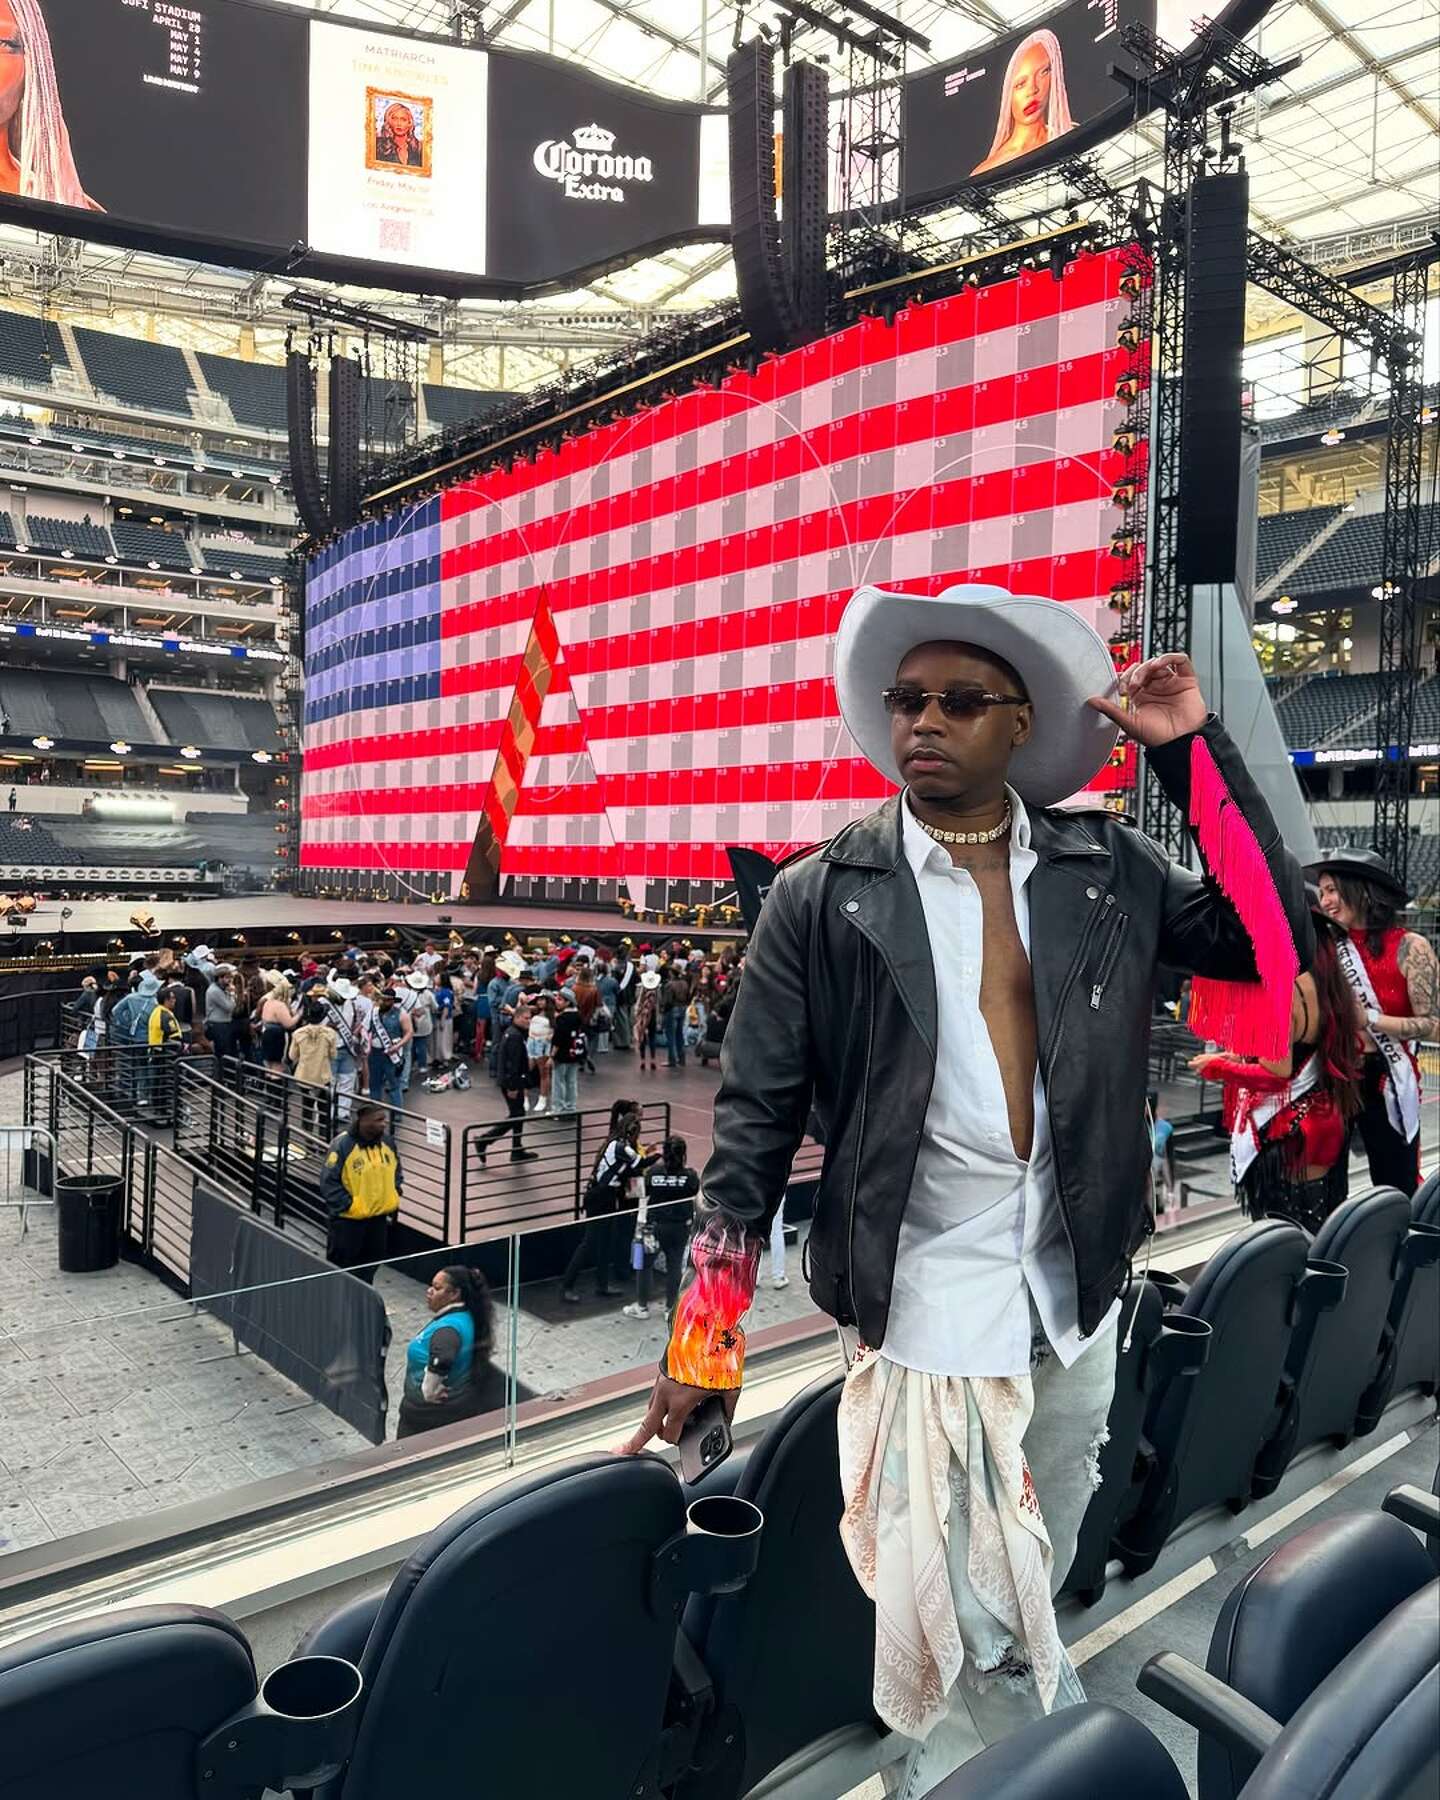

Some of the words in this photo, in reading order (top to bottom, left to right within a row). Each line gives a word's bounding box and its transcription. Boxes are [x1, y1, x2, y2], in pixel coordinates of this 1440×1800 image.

[154, 2, 200, 22] STADIUM
[152, 14, 182, 30] APRIL
[188, 23, 200, 34] 28
[170, 30, 188, 42] MAY
[194, 36, 200, 44] 1
[170, 41, 188, 53] MAY
[194, 48, 200, 56] 4
[364, 44, 436, 65] MATRIARCH
[170, 53, 188, 64] MAY
[194, 59, 200, 68] 7
[170, 64, 188, 76] MAY
[193, 70, 200, 79] 9
[533, 140, 654, 183] Corona
[565, 174, 624, 202] Extra
